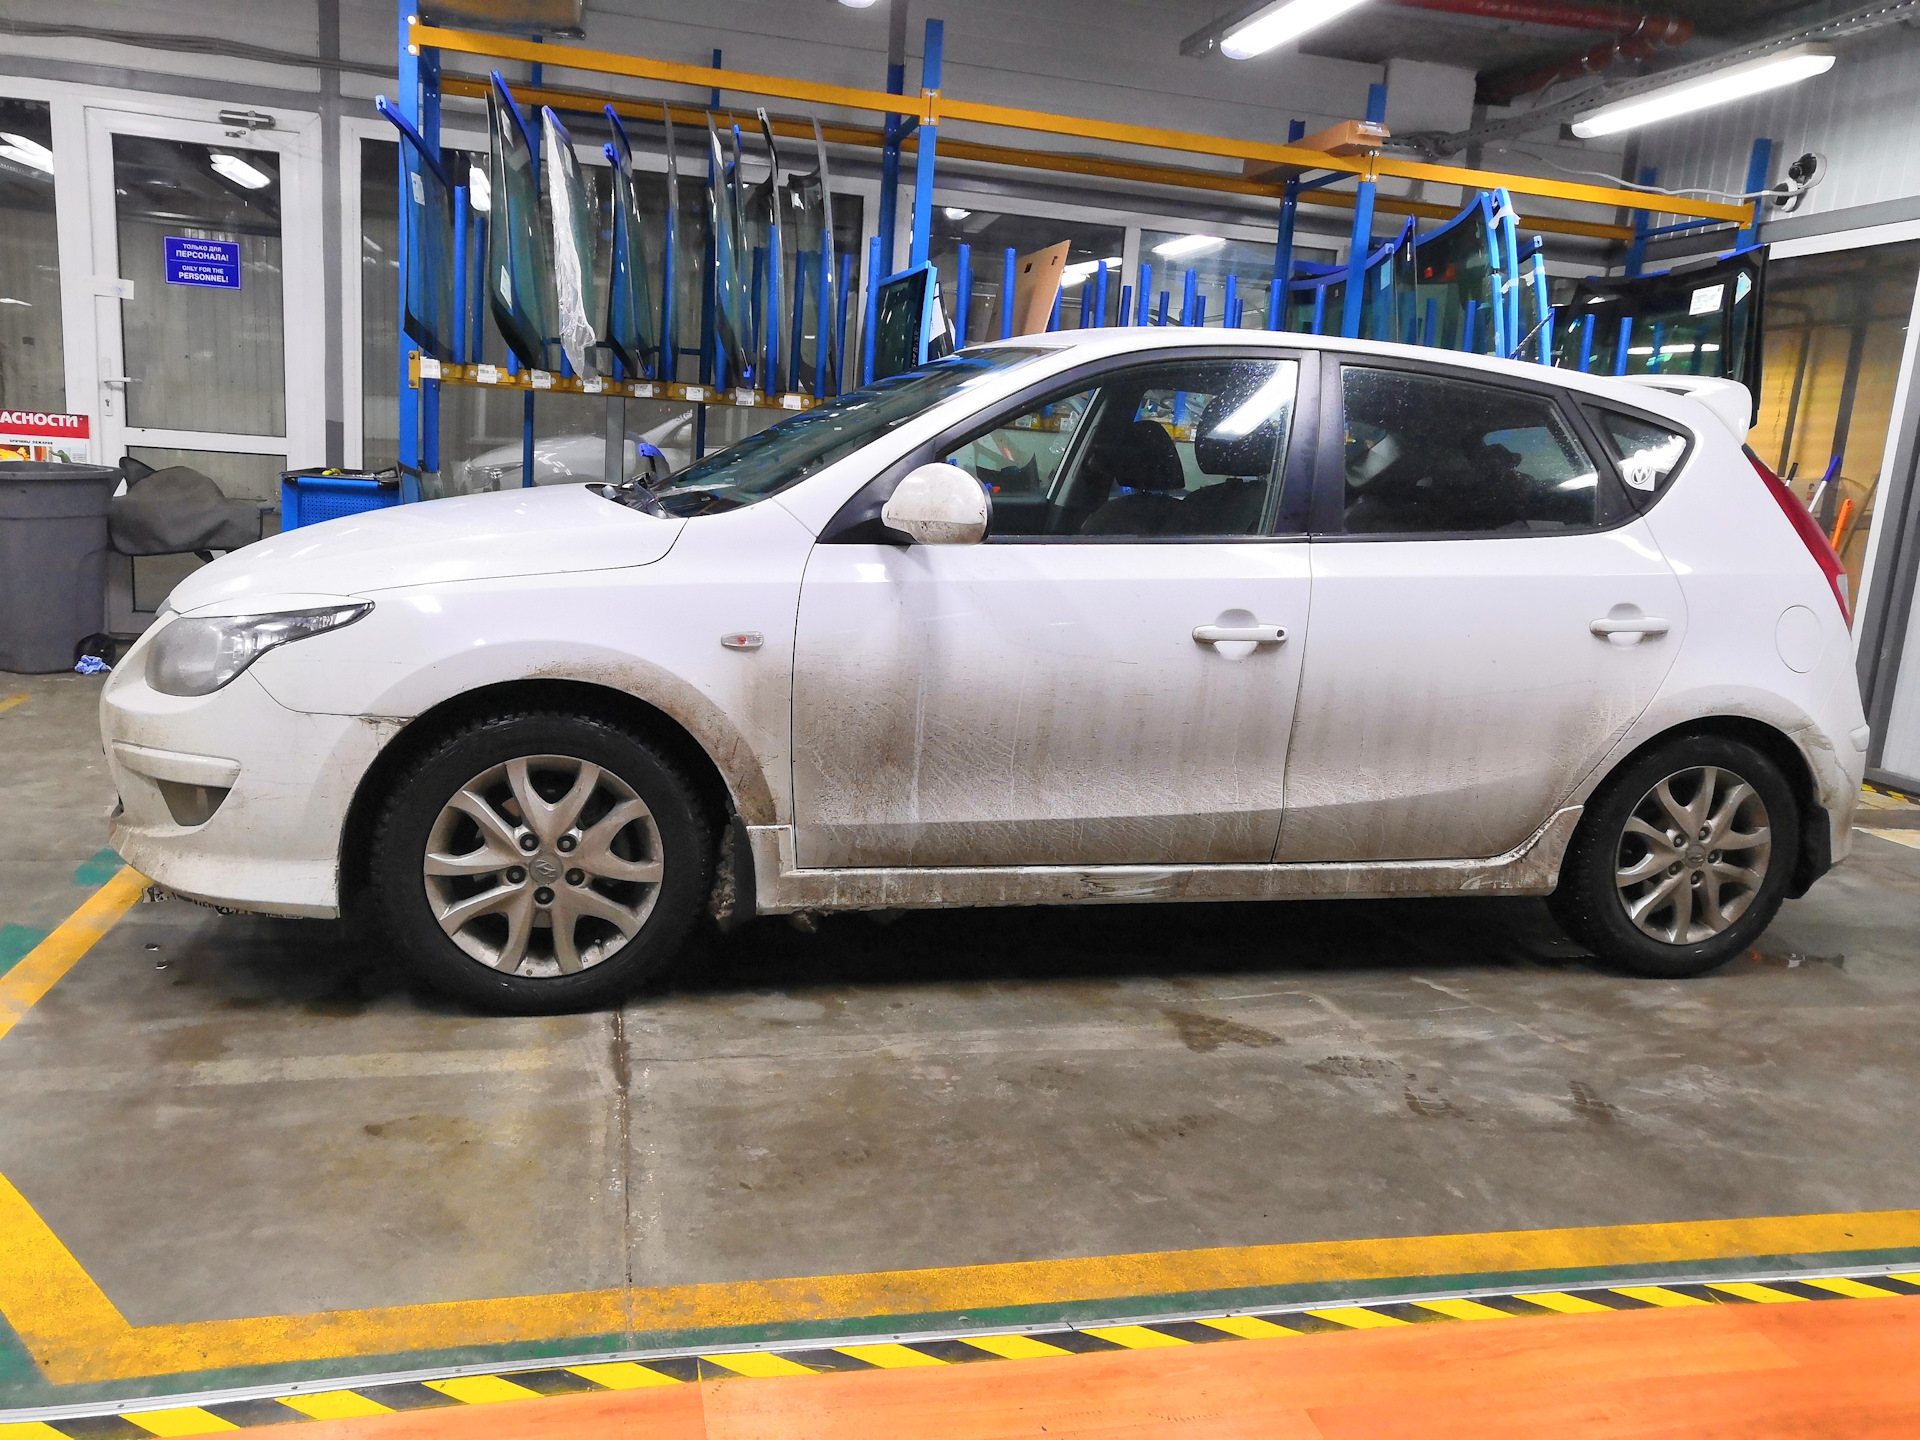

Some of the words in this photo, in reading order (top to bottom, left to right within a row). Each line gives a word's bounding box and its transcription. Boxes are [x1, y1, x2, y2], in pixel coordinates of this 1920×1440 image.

[183, 243, 208, 251] ТОЛЬКО
[208, 245, 222, 253] ДЛЯ
[176, 249, 229, 262] ПЕРСОНАЛА!
[178, 271, 229, 283] PERSONNEL!
